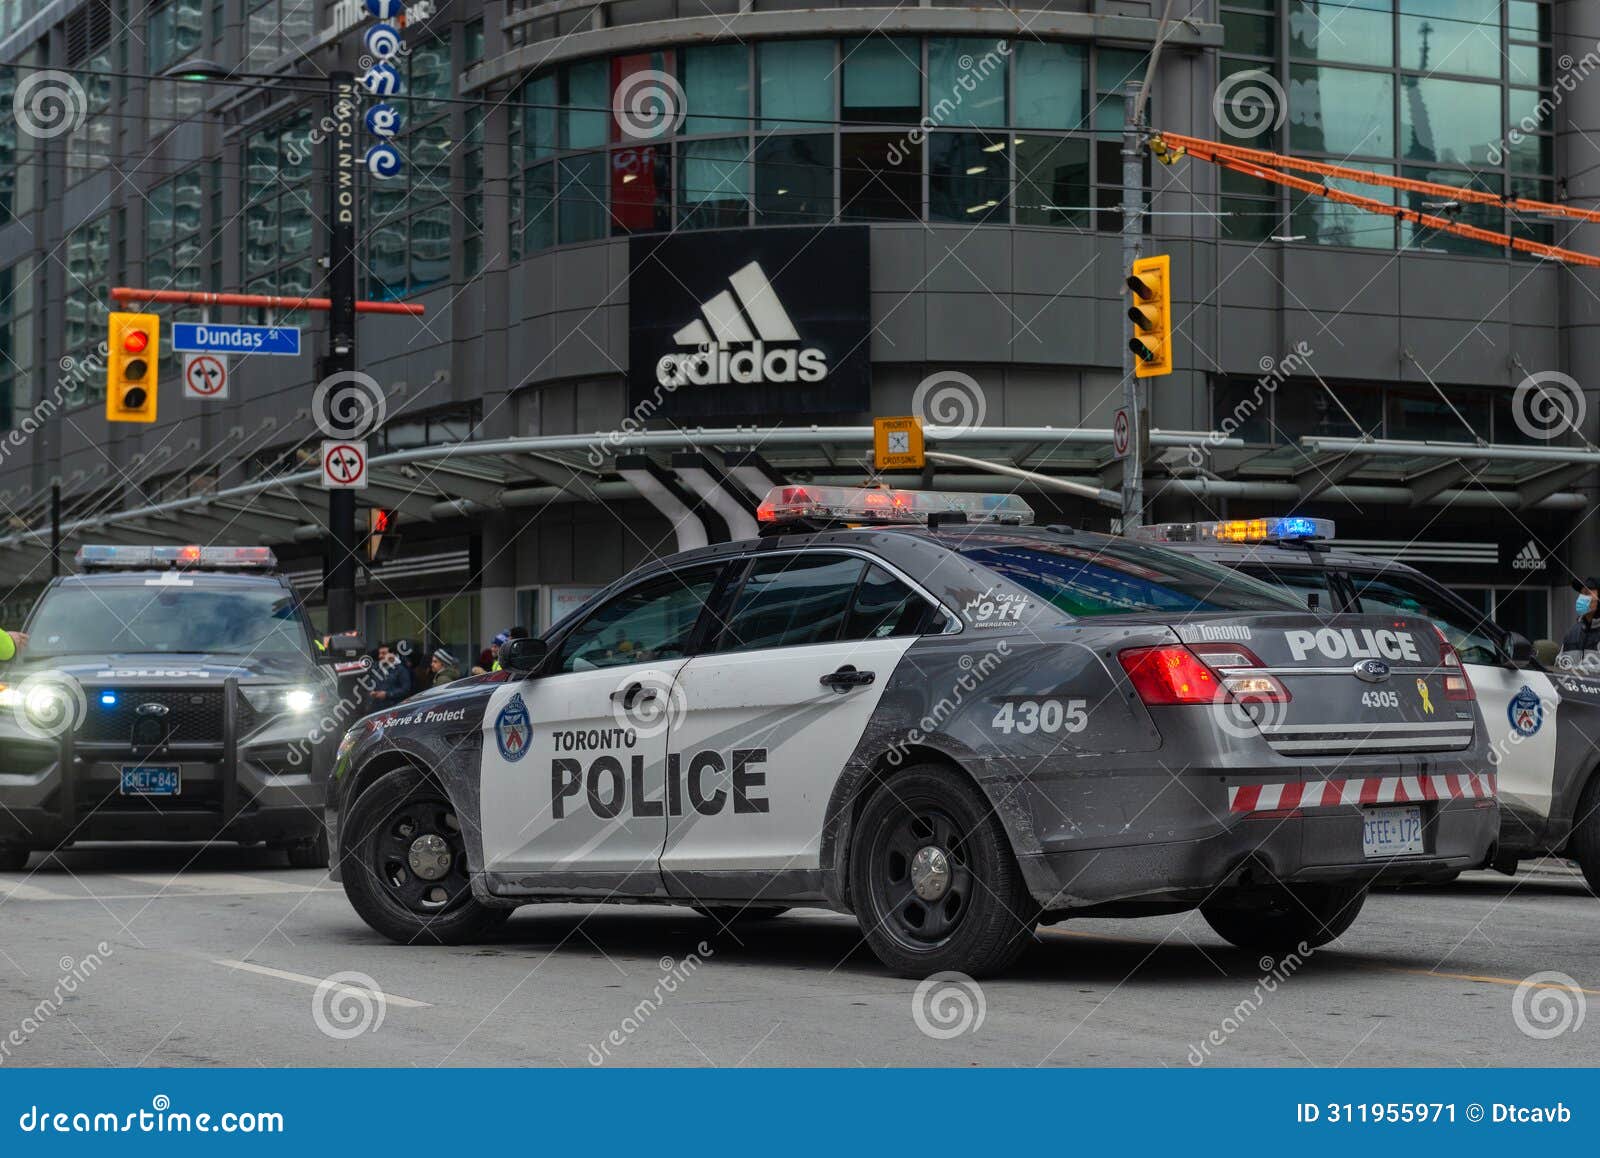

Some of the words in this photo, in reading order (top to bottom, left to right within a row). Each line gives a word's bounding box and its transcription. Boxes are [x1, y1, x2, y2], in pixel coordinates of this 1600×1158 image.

[195, 326, 263, 347] Dundas
[268, 329, 279, 340] St
[656, 340, 828, 387] adidas
[882, 421, 913, 429] PRIORITY
[882, 455, 917, 465] CROSSING
[1512, 559, 1547, 570] adidas
[996, 593, 1029, 603] CALL
[974, 621, 1018, 634] EMERGENCY
[1284, 628, 1422, 662] POLICE
[1361, 691, 1399, 708] 4305
[384, 715, 413, 728] Serve
[413, 713, 422, 725] &
[424, 707, 465, 723] Protect
[991, 699, 1089, 735] 4305
[552, 727, 637, 752] TORONTO
[551, 748, 770, 820] POLICE
[1400, 818, 1421, 843] 172
